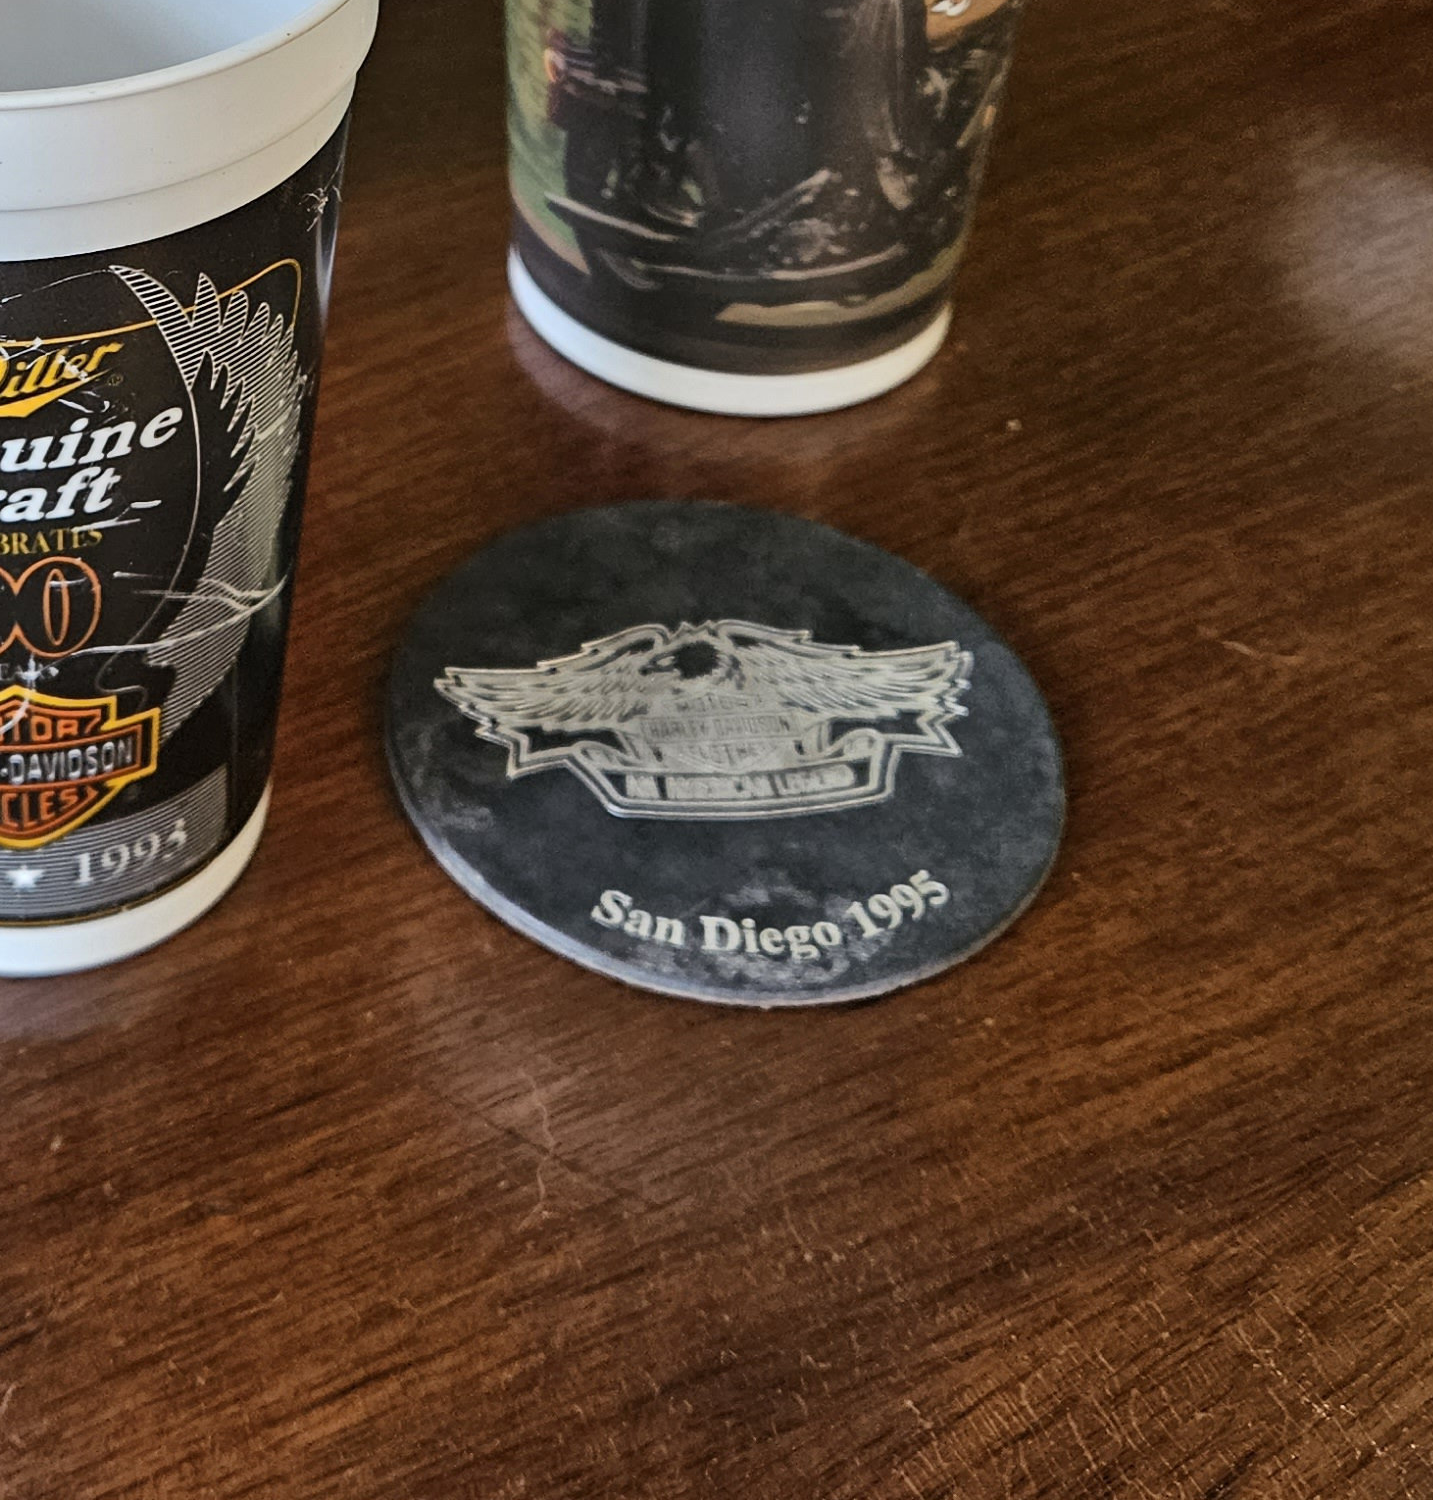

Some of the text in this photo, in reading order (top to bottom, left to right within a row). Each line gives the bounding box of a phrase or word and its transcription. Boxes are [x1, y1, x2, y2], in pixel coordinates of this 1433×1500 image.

[74, 816, 189, 886] 1993
[590, 869, 951, 961] San Diego 1995
